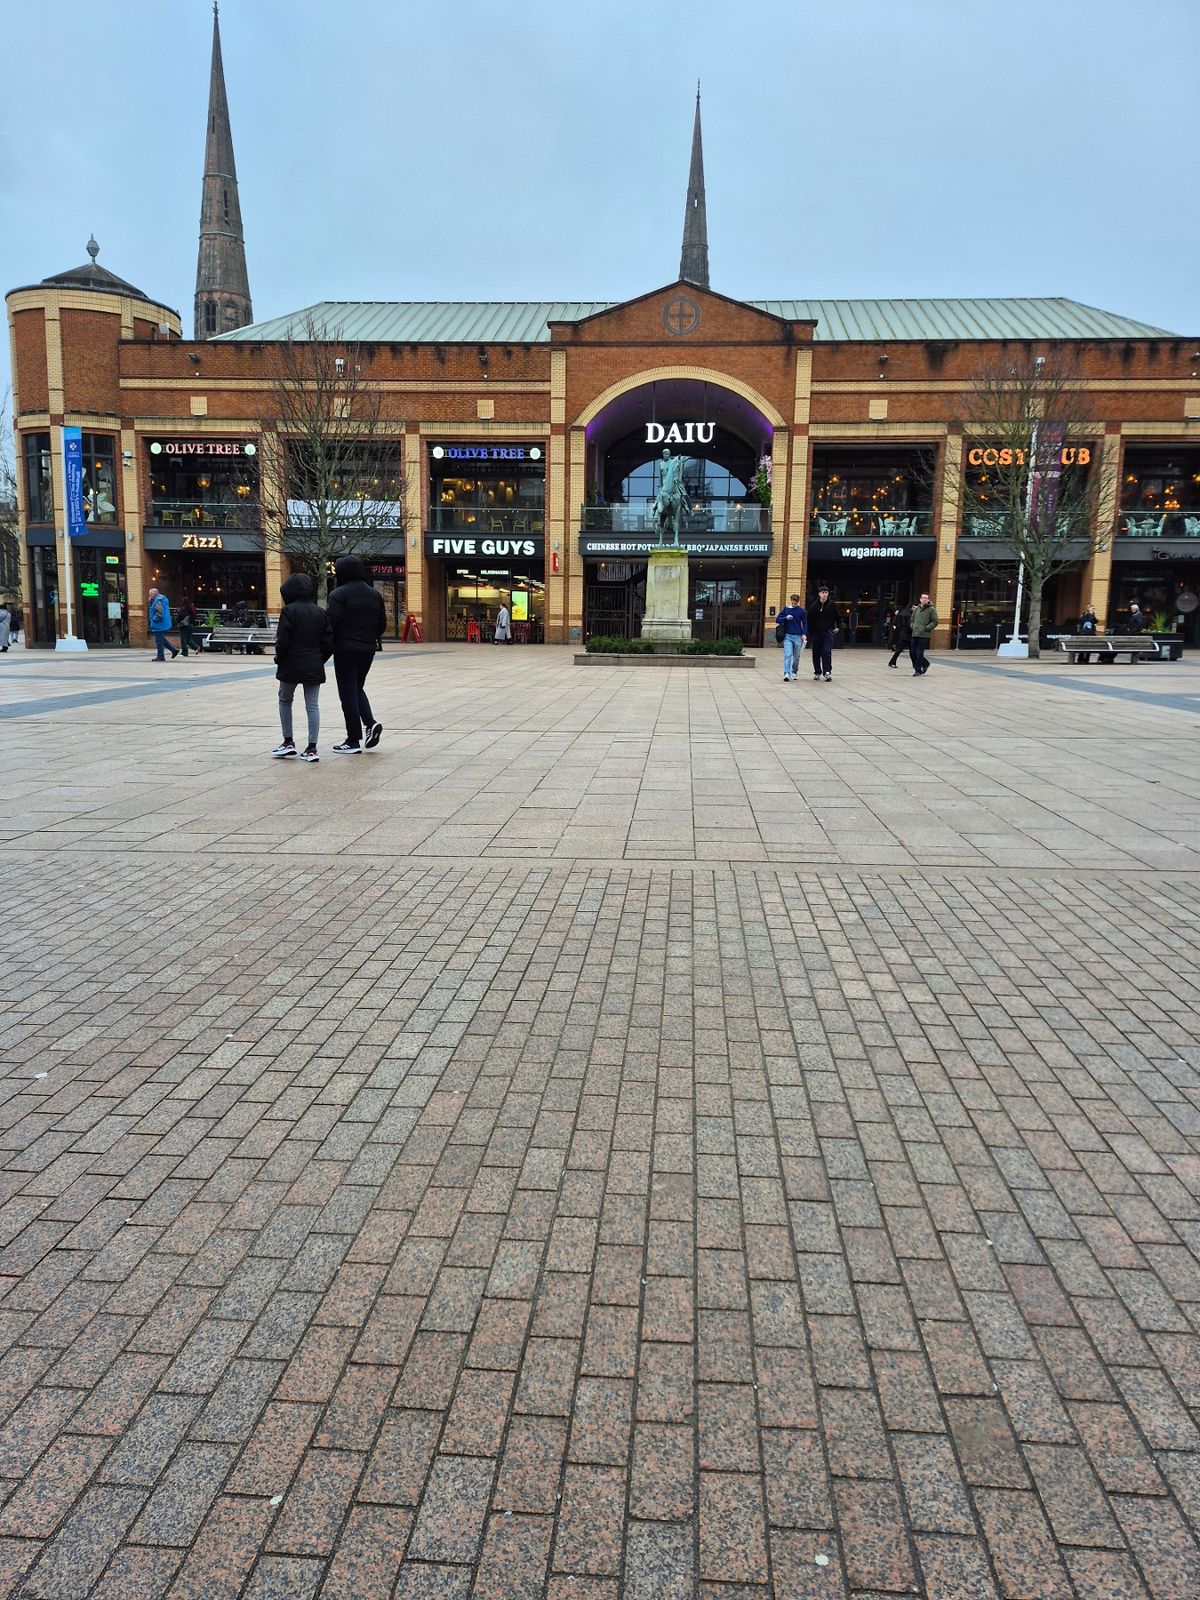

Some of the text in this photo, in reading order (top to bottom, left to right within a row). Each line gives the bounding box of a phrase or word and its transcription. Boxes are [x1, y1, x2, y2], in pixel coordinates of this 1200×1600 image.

[645, 422, 716, 443] DAIU
[165, 443, 240, 455] OLIVE TREE
[448, 447, 525, 459] OLIVE TREE
[182, 534, 222, 548] Zizzi
[433, 539, 535, 556] FIVE GUYS
[586, 543, 620, 551] CHINESE
[620, 543, 636, 551] HOT
[744, 544, 768, 552] SUSHI
[841, 547, 904, 559] wagamama
